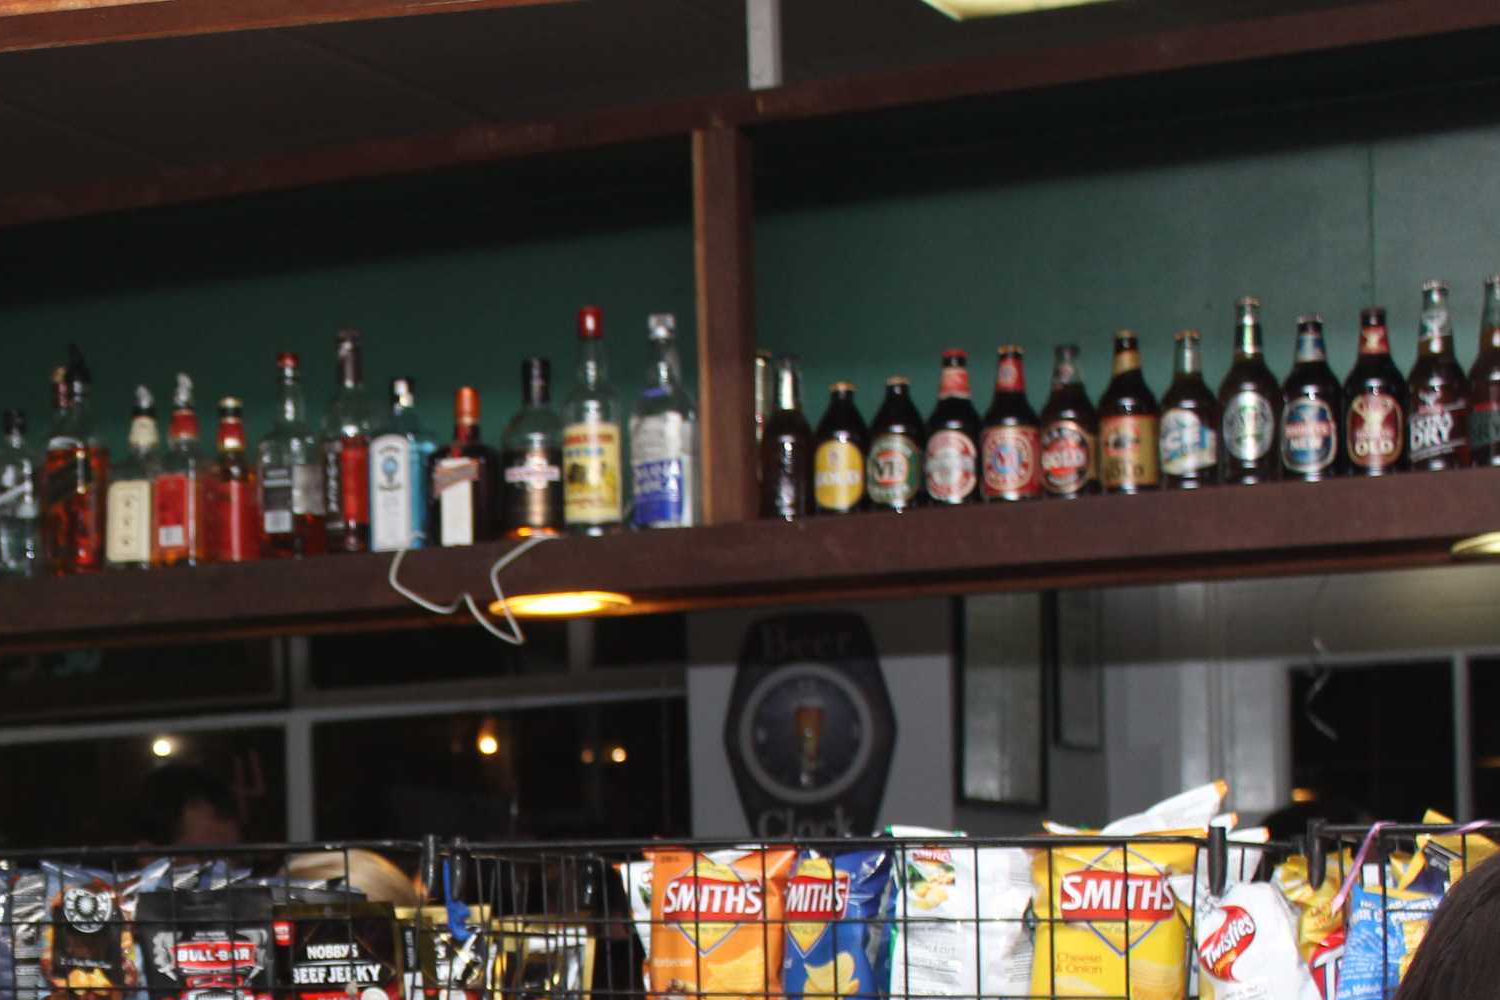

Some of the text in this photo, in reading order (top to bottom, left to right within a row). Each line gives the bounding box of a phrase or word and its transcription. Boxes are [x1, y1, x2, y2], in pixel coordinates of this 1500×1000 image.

[1410, 422, 1452, 452] DRY
[1354, 440, 1395, 456] OLD
[757, 807, 854, 838] Clock
[306, 943, 359, 960] NOBBYS
[1203, 915, 1257, 968] Twisties
[327, 963, 382, 984] JEKY
[1065, 962, 1104, 975] Onion
